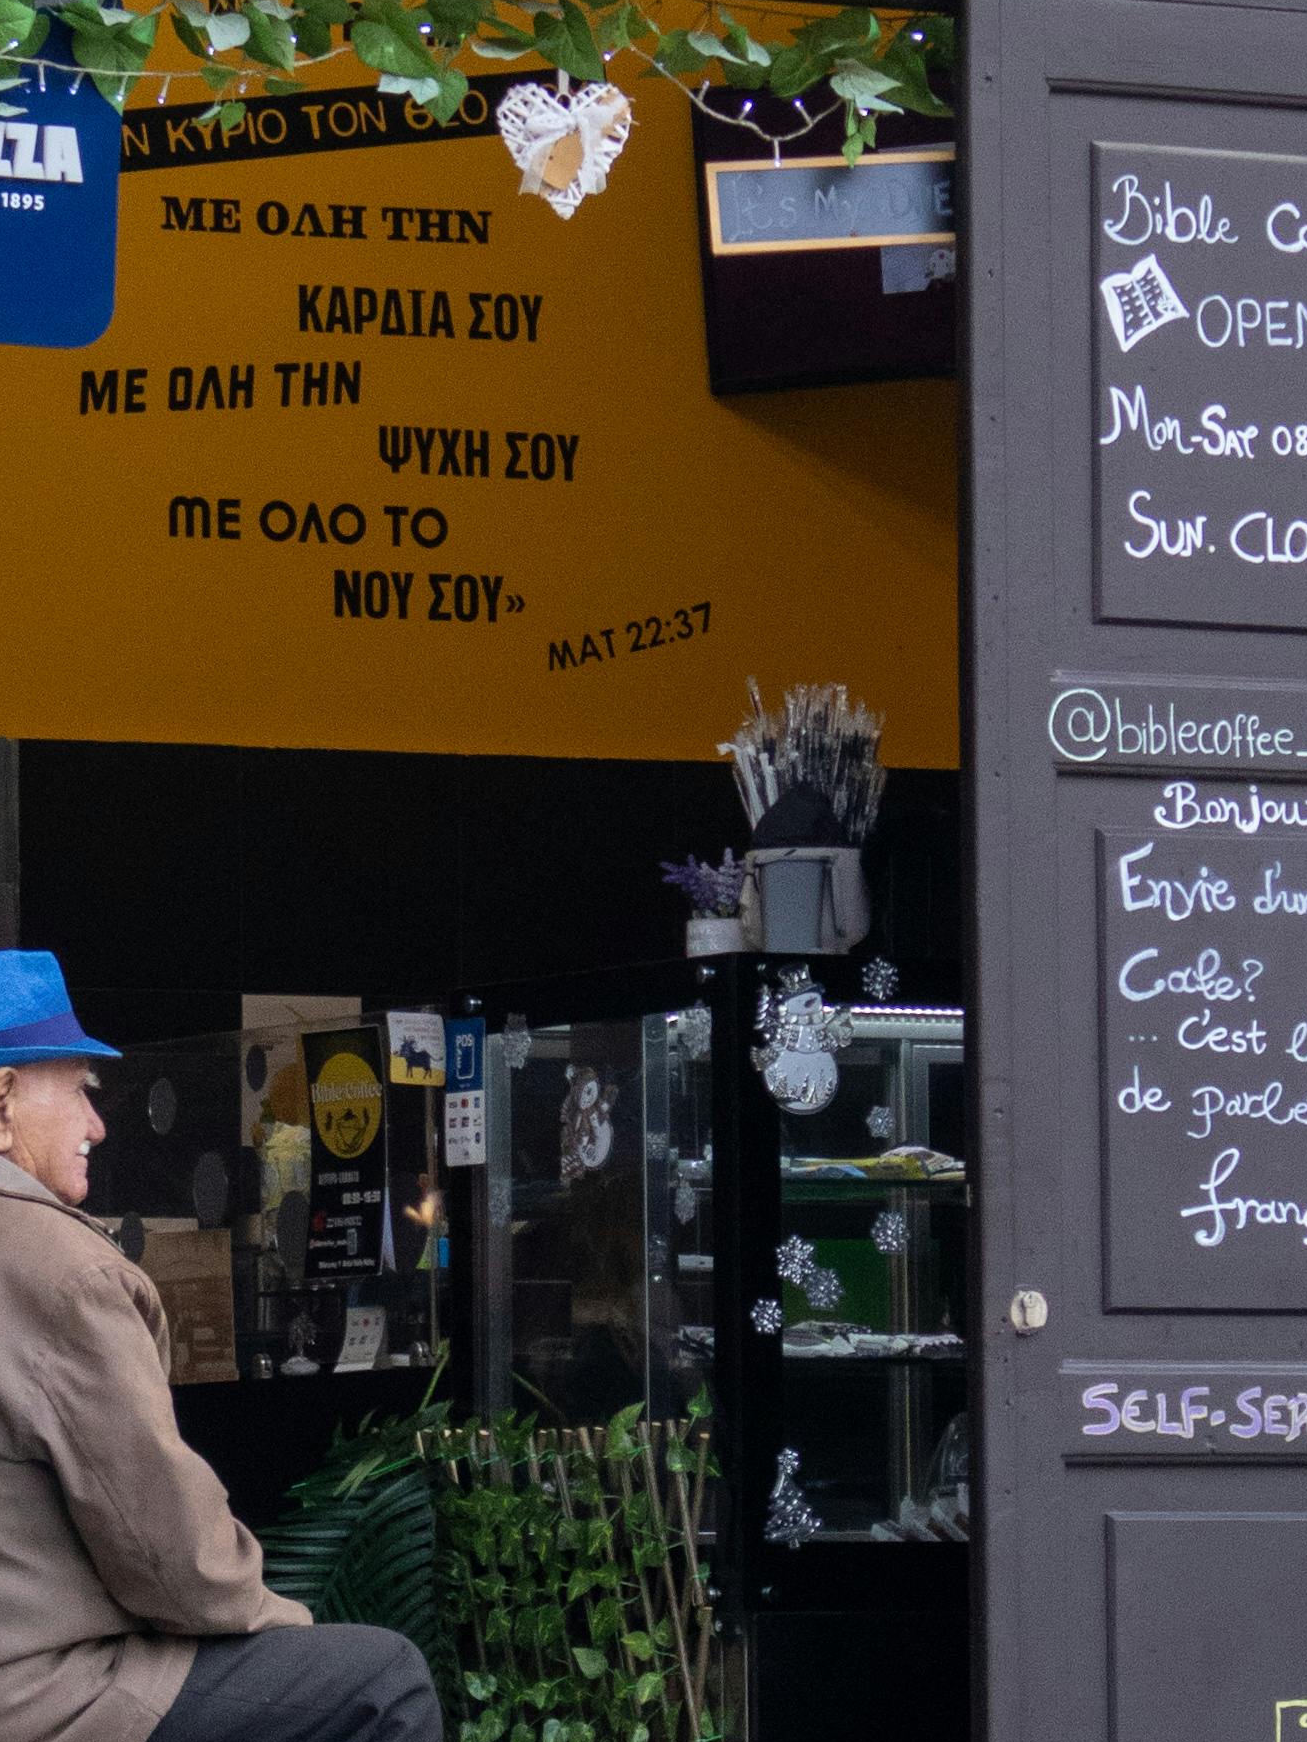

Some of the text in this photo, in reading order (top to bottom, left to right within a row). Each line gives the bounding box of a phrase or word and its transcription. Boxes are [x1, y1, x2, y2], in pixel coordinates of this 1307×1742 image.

[302, 99, 387, 140] ΤΟΝ
[404, 89, 488, 132] ΘΟ
[0, 191, 45, 211] 1895
[161, 196, 493, 246] ΜΕ ΟΛΗ ΤΗΝ
[1103, 174, 1238, 246] Bible
[298, 283, 543, 343] ΚΑΡΔΙΑ ΣΟΥ
[78, 359, 362, 416] ΜΕ ΟΛΗ ΤΗΝ
[378, 425, 580, 481] ΨΥΧΗ ΣΟΥ
[168, 496, 449, 549] ΜΕ ΟΛΟ ΤΟ
[333, 569, 413, 621] ΝΟΥ
[625, 600, 712, 653] 22:37
[1119, 842, 1236, 921] Envie
[1117, 1065, 1172, 1115] de
